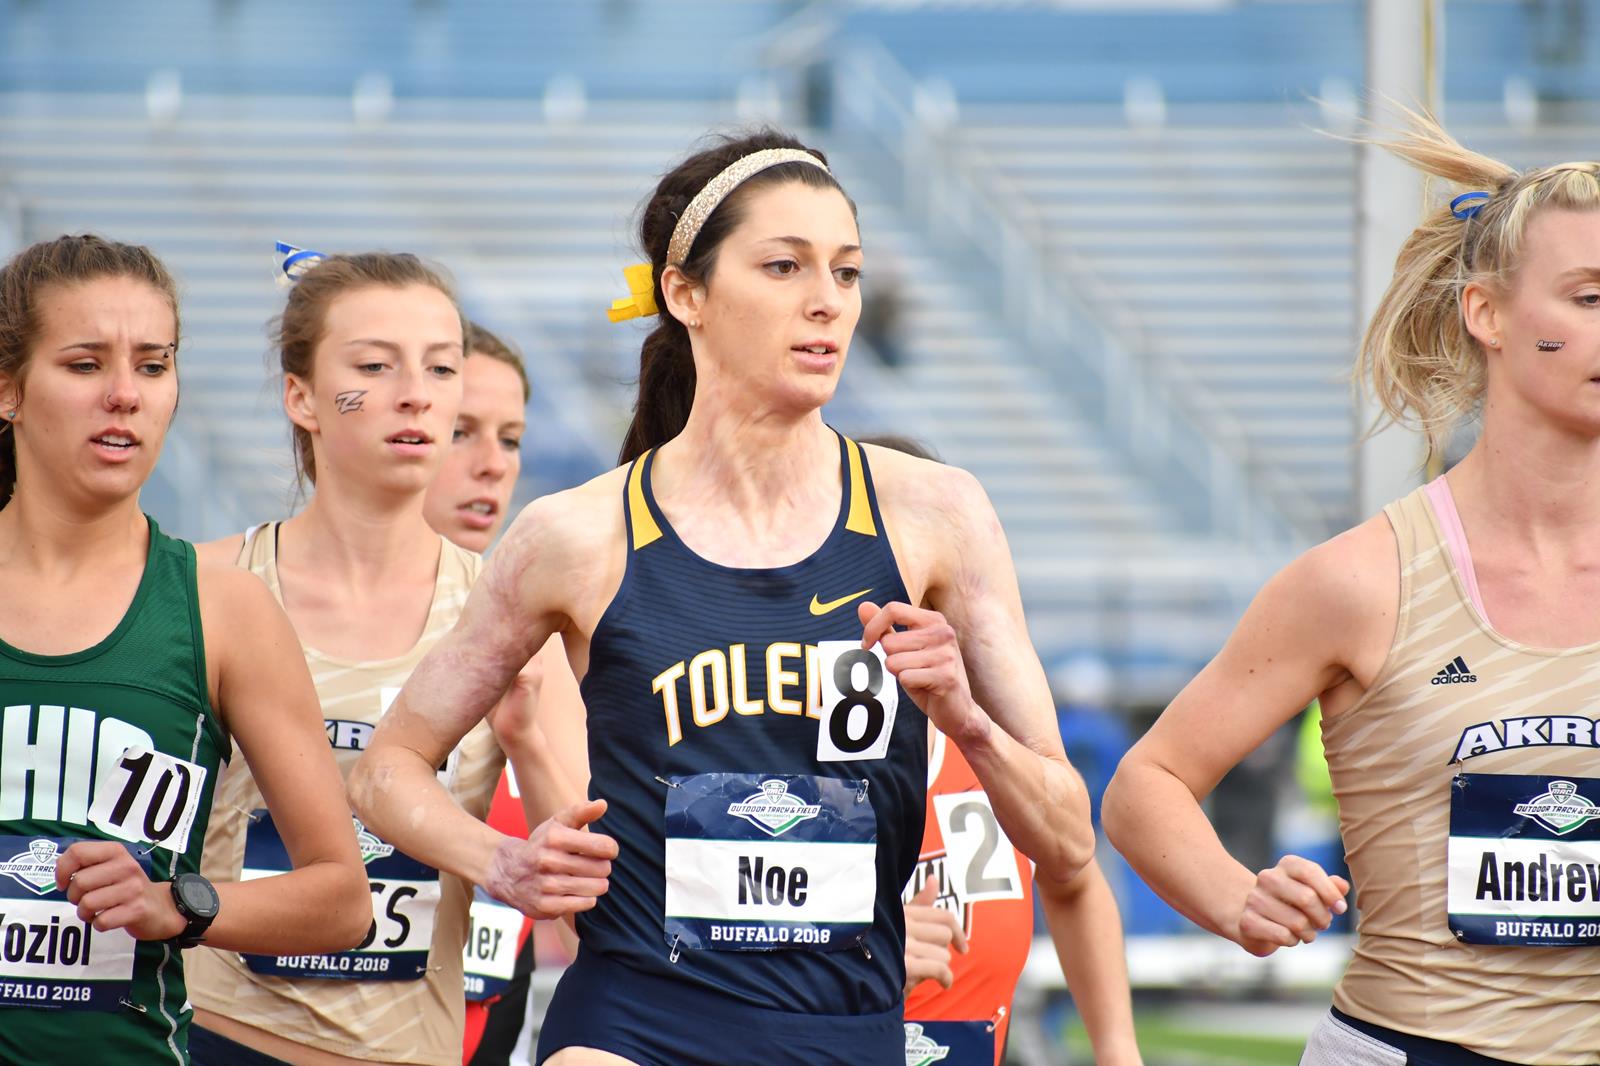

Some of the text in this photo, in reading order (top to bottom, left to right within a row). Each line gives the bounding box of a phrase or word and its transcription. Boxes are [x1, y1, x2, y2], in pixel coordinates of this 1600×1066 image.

[1431, 674, 1477, 685] adidas
[829, 649, 885, 753] 8
[1447, 715, 1600, 766] AKR
[108, 752, 191, 841] 10
[730, 805, 766, 813] OUTDOOR
[767, 806, 790, 814] TRACK
[796, 807, 818, 815] FIELD
[1516, 805, 1551, 813] OUTDOOR
[1552, 806, 1578, 814] TRACK
[949, 801, 1012, 895] 2
[738, 856, 808, 907] Noe
[711, 925, 831, 943] BUFFALO 2018
[1496, 921, 1574, 938] BUFFALO
[276, 955, 389, 971] BUFFALO 2018
[52, 986, 91, 1001] 2018
